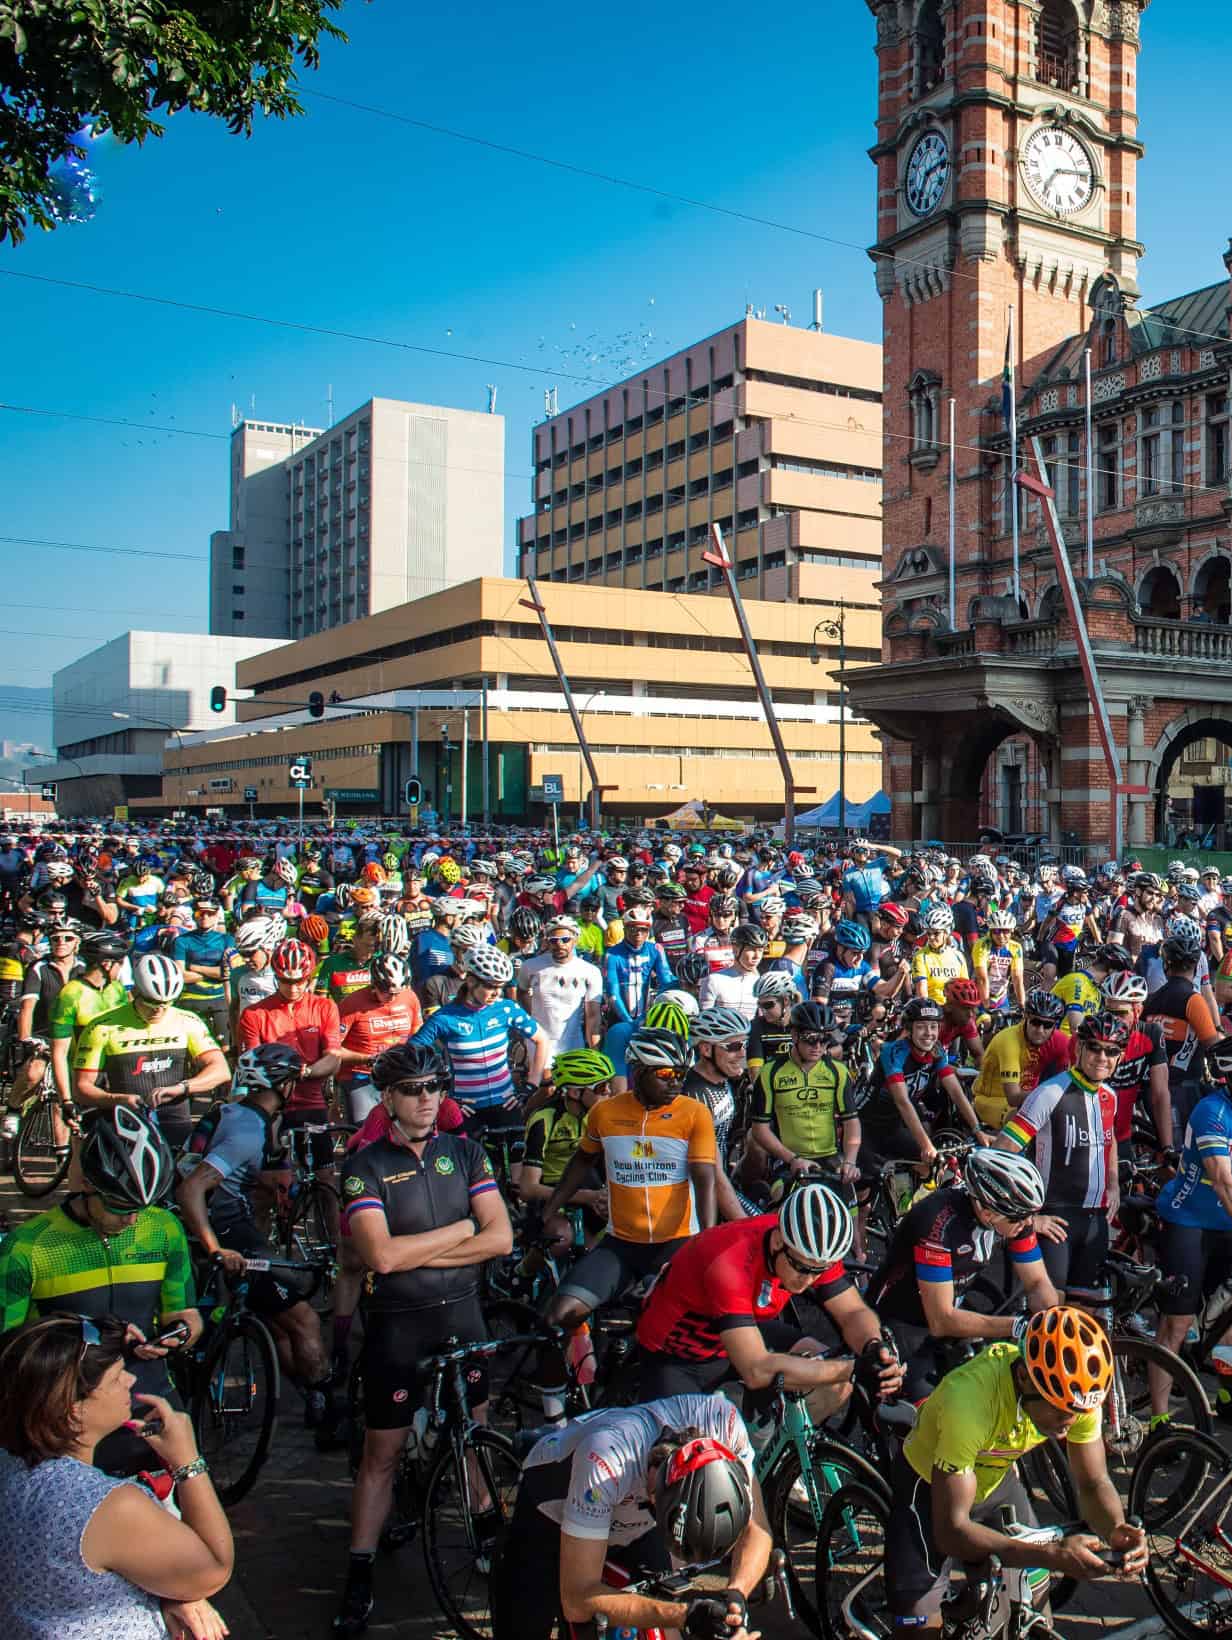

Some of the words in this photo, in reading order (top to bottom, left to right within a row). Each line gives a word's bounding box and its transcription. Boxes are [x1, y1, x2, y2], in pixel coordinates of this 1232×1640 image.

[289, 765, 312, 780] CL
[543, 782, 561, 794] BL
[117, 1035, 180, 1048] TREK
[1171, 1181, 1192, 1209] CYCLE
[1187, 1162, 1199, 1183] LAB
